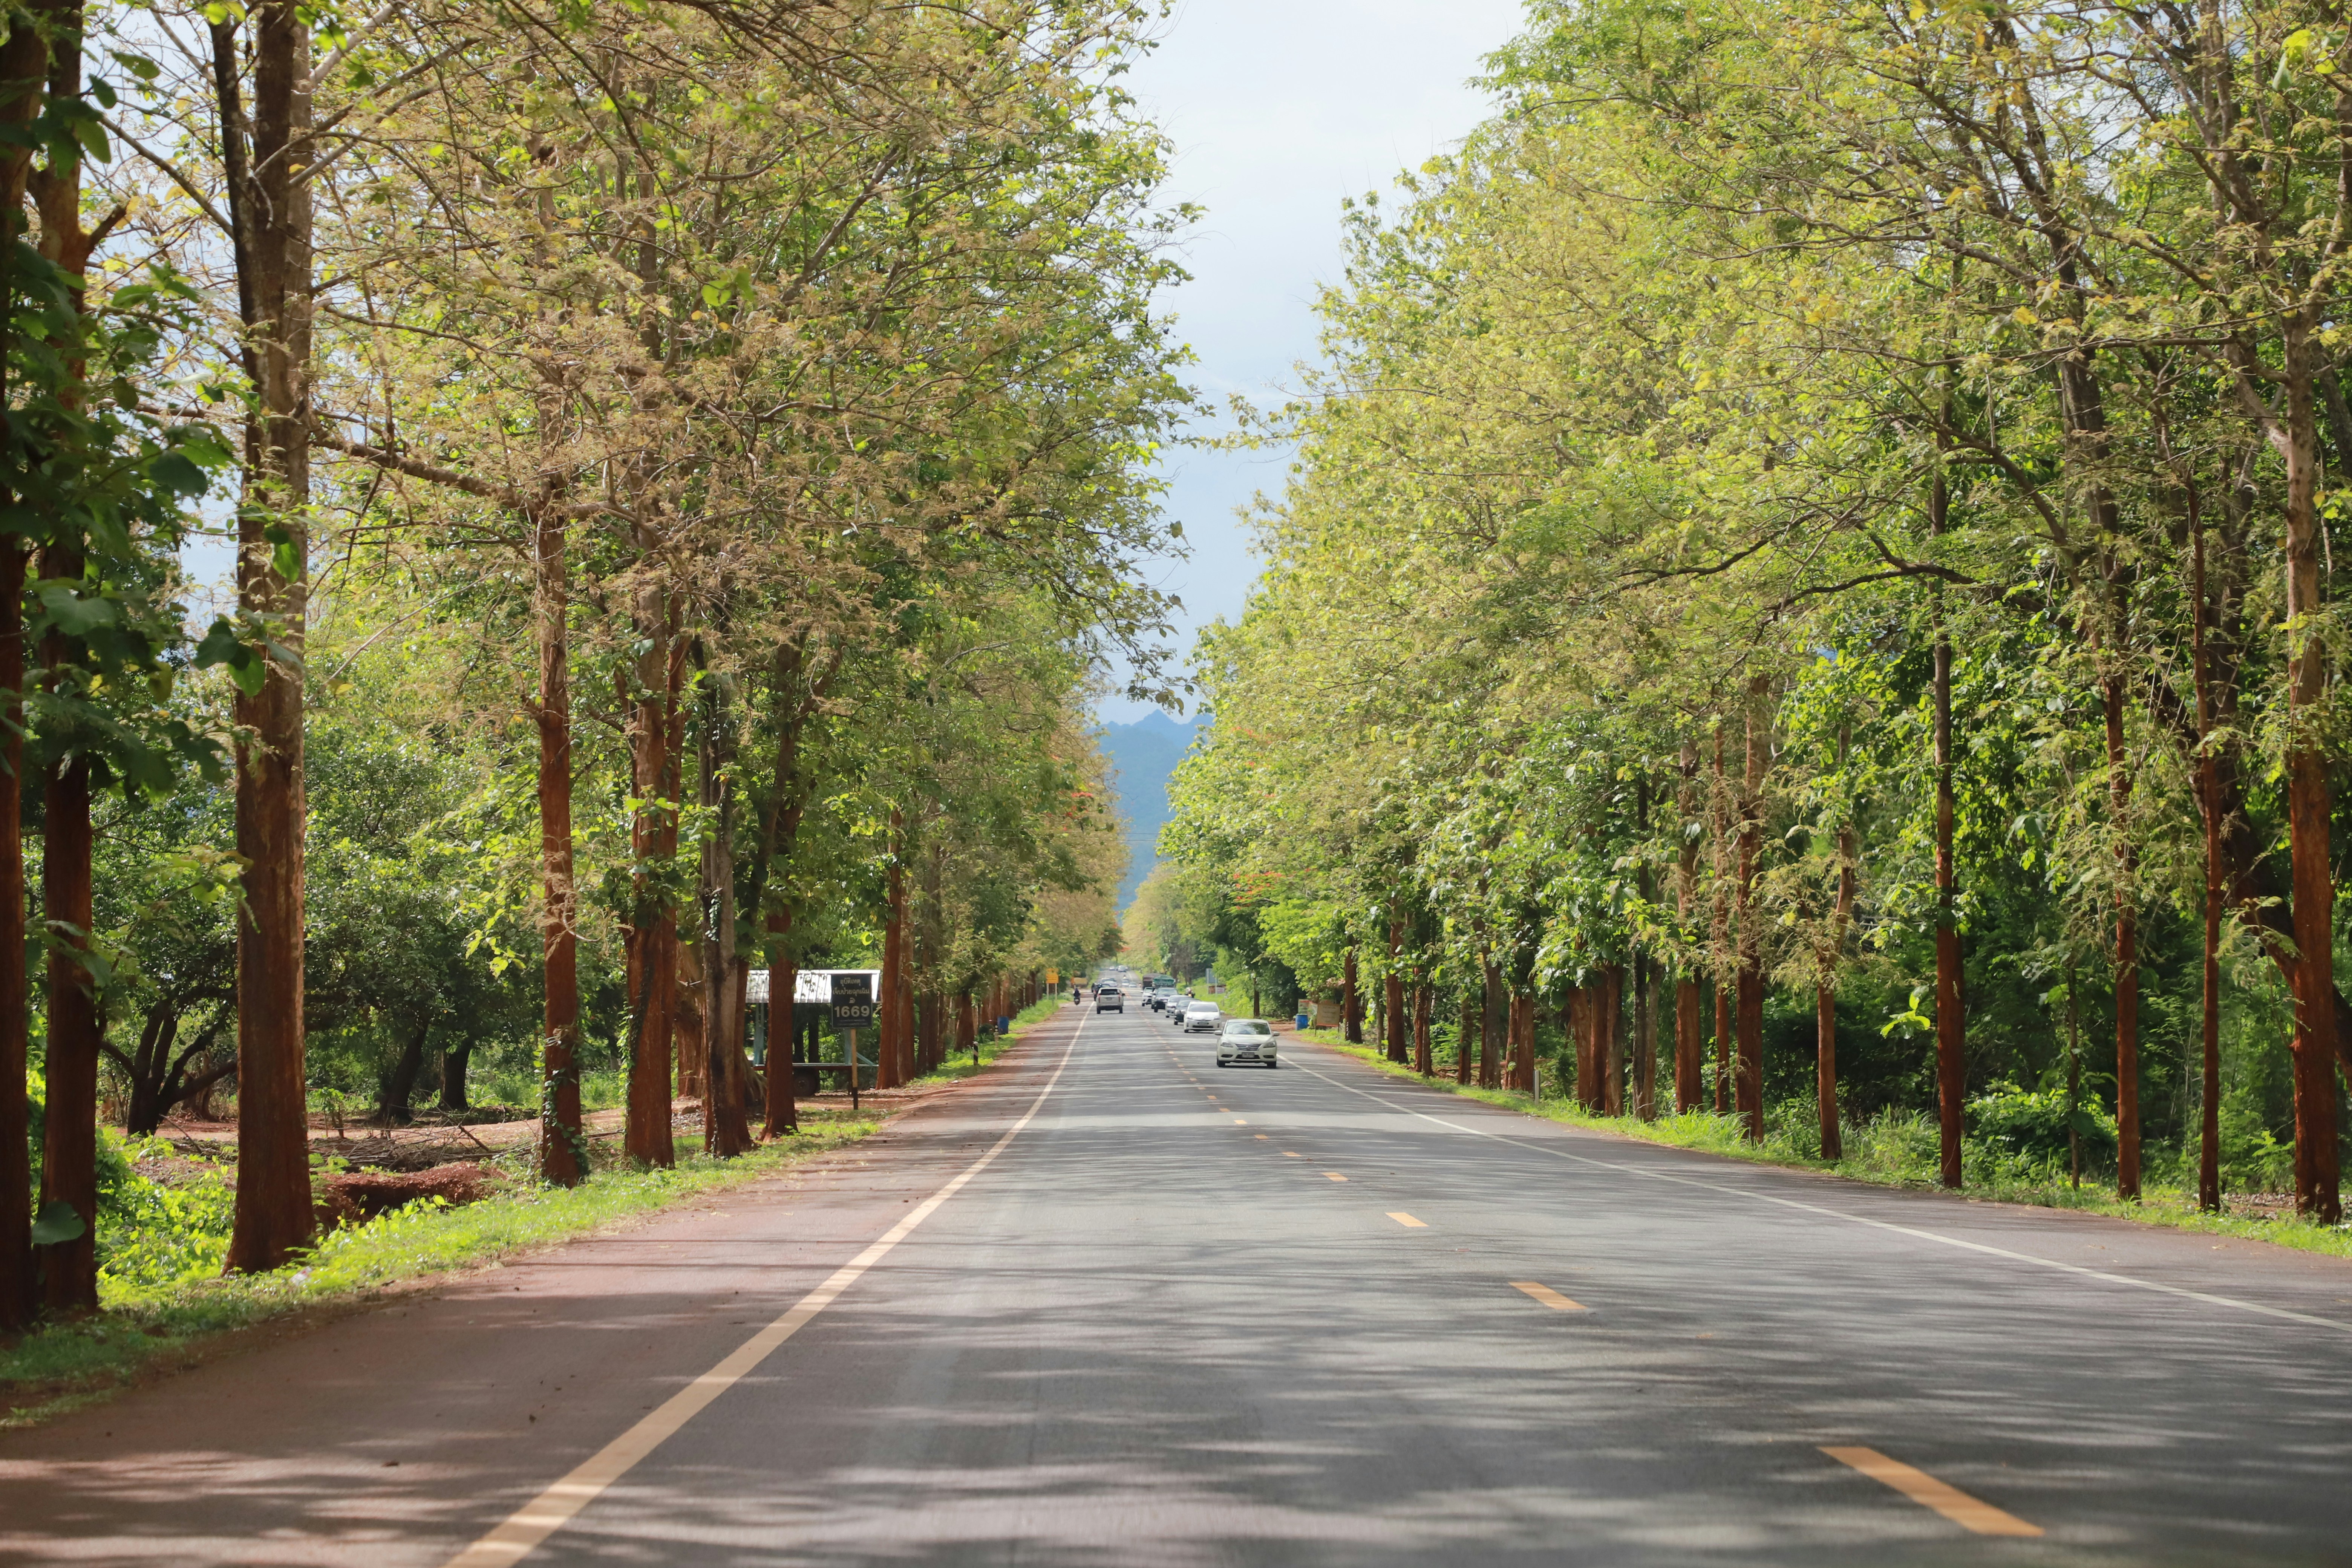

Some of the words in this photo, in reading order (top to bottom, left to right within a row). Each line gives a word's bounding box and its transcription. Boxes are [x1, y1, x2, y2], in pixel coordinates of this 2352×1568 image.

[840, 977, 861, 986] อุบัติเหตุ
[834, 1005, 870, 1017] 1669
